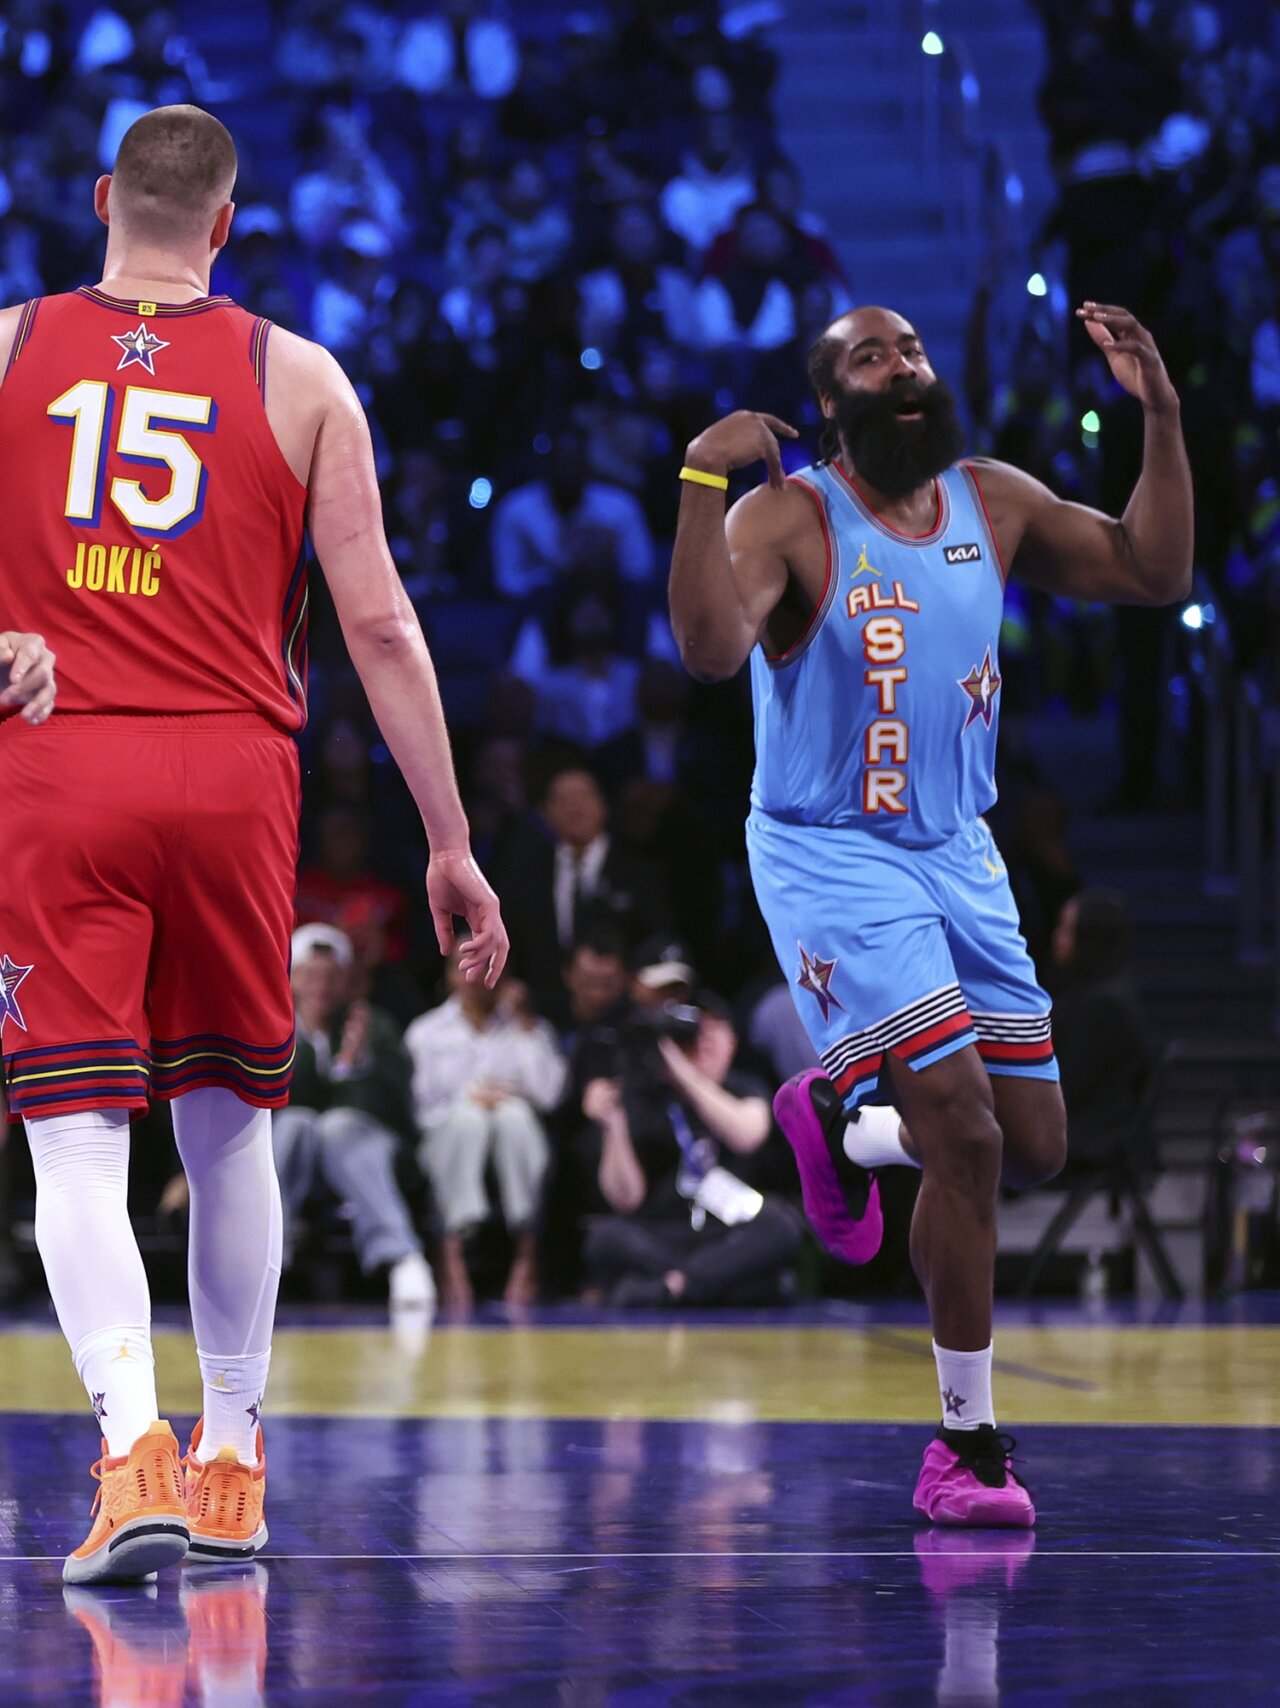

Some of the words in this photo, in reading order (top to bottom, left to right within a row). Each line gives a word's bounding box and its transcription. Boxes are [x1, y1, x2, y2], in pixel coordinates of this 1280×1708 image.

[47, 379, 218, 541] 15
[66, 543, 162, 597] JOKIĆ
[848, 582, 919, 617] ALL
[863, 617, 908, 813] STAR
